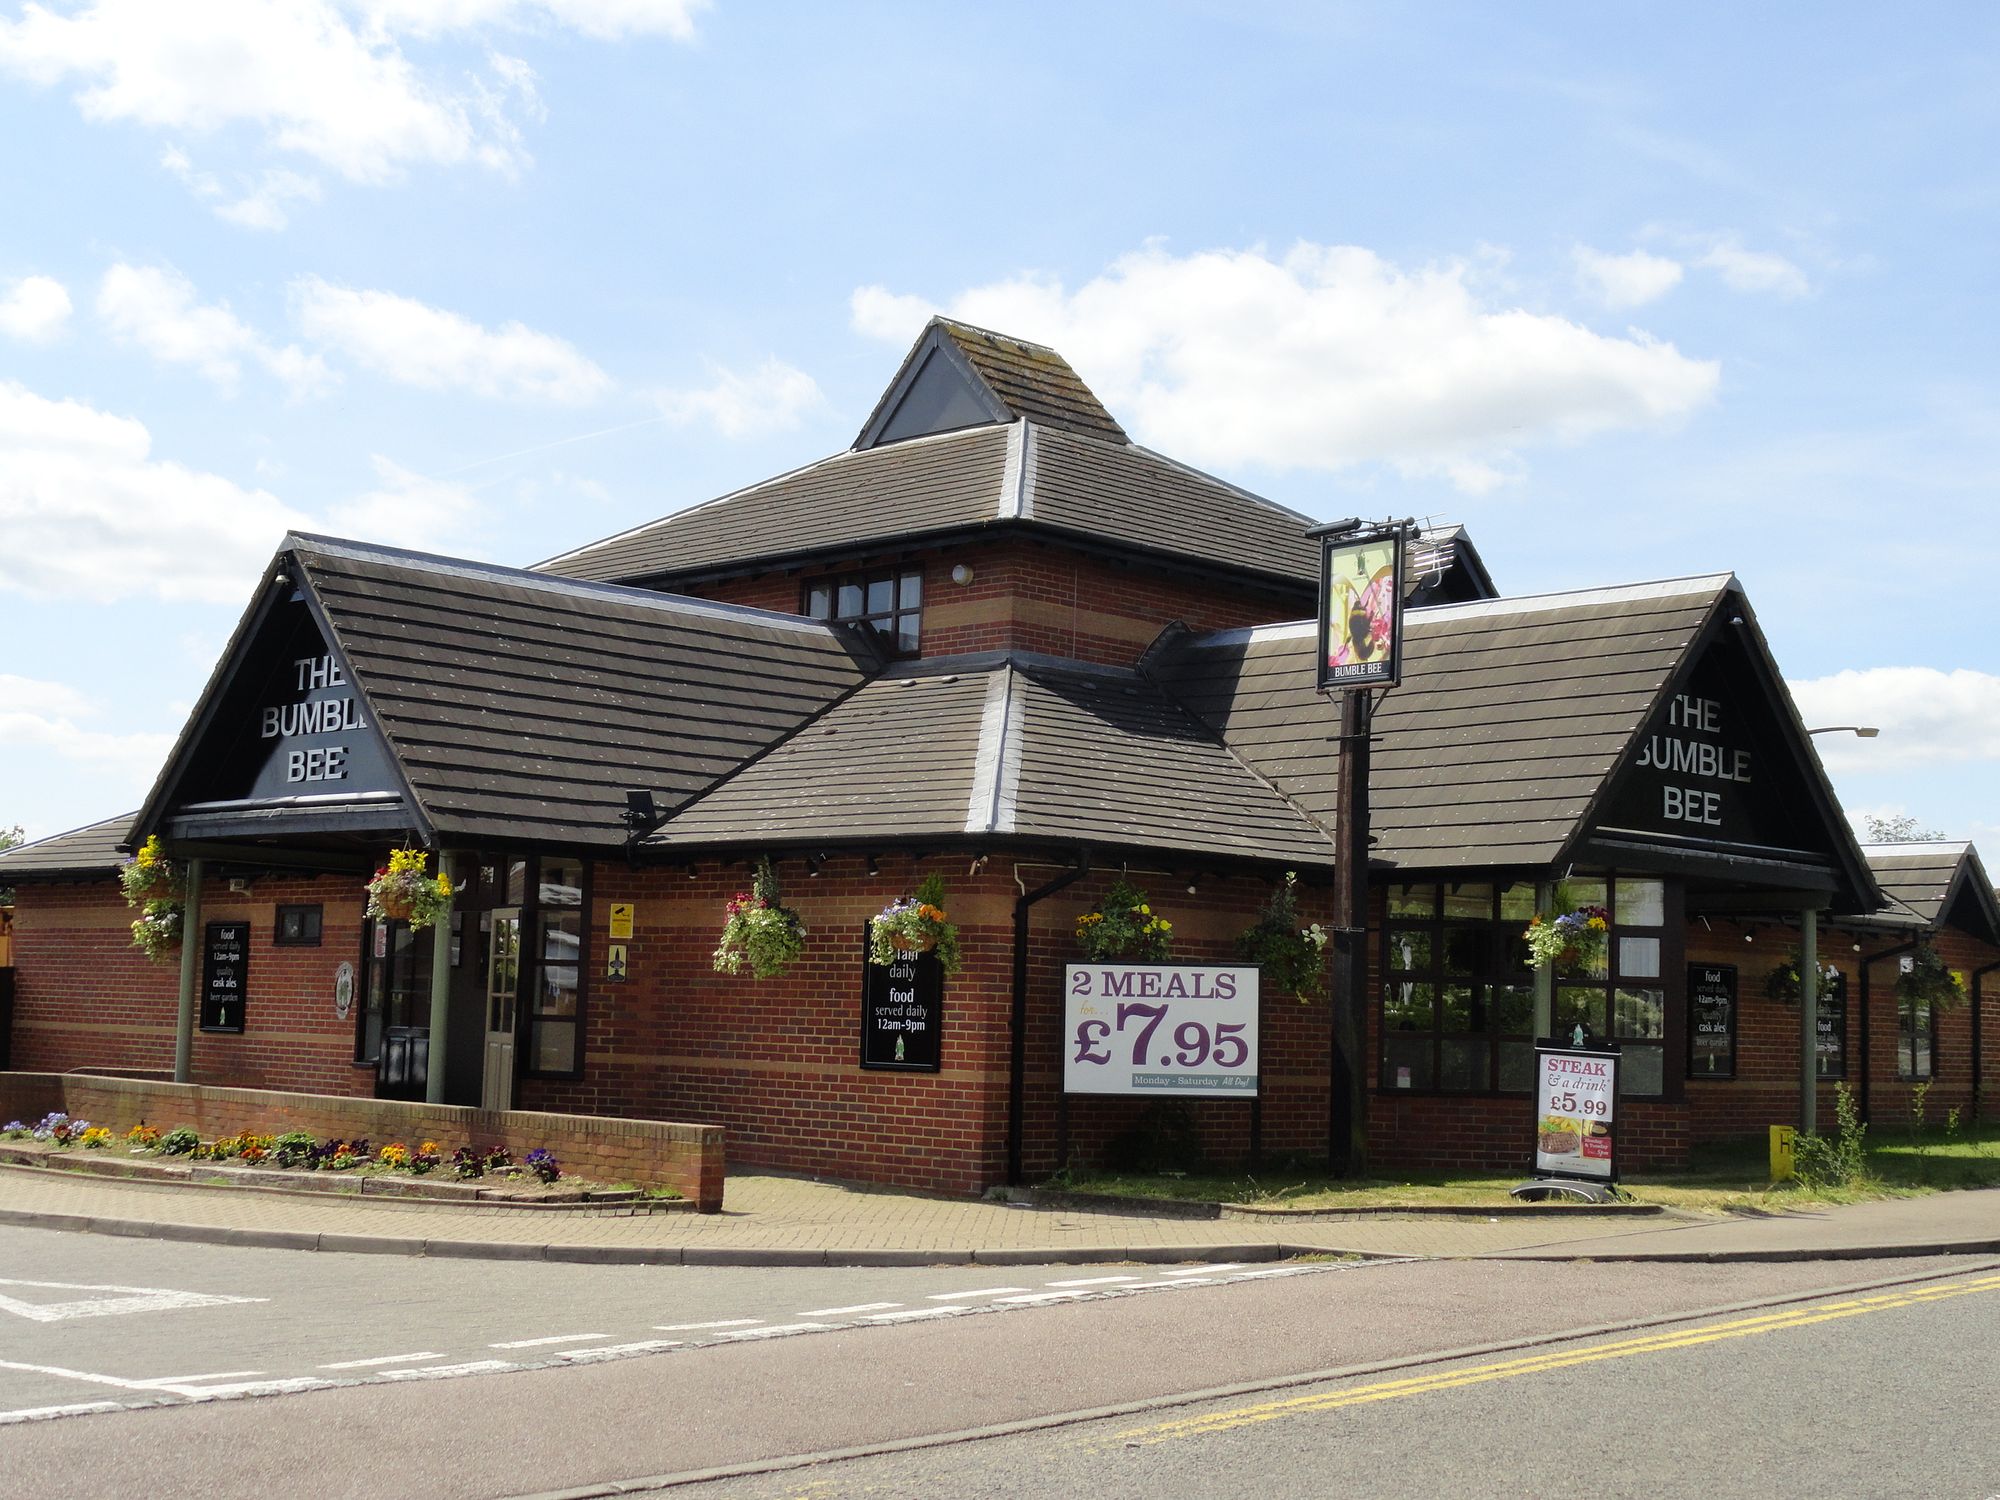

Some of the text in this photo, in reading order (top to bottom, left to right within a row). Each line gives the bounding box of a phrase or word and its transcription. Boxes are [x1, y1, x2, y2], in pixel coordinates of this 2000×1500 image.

[294, 655, 347, 690] THE
[1335, 663, 1382, 678] BUMBLE BEE
[1669, 694, 1721, 733] THE
[287, 746, 345, 782] BEE
[1663, 785, 1722, 826] BEE
[220, 928, 235, 940] food
[889, 964, 916, 982] daily
[1705, 970, 1721, 983] food
[212, 977, 237, 988] cask ales
[1071, 970, 1237, 1000] 2 MEALS
[889, 987, 914, 1003] food
[875, 1005, 928, 1020] served daily
[877, 1018, 926, 1033] 12am-9pm
[1698, 1021, 1726, 1033] cask ales
[1817, 1020, 1832, 1032] food
[1073, 1002, 1249, 1068] £7.95
[1547, 1058, 1607, 1077] STEAK
[1134, 1076, 1170, 1087] Monday
[1177, 1076, 1219, 1087] Saturday
[1222, 1076, 1233, 1086] All
[1547, 1073, 1561, 1087] &
[1562, 1079, 1570, 1088] a
[1550, 1091, 1607, 1116] £5.99
